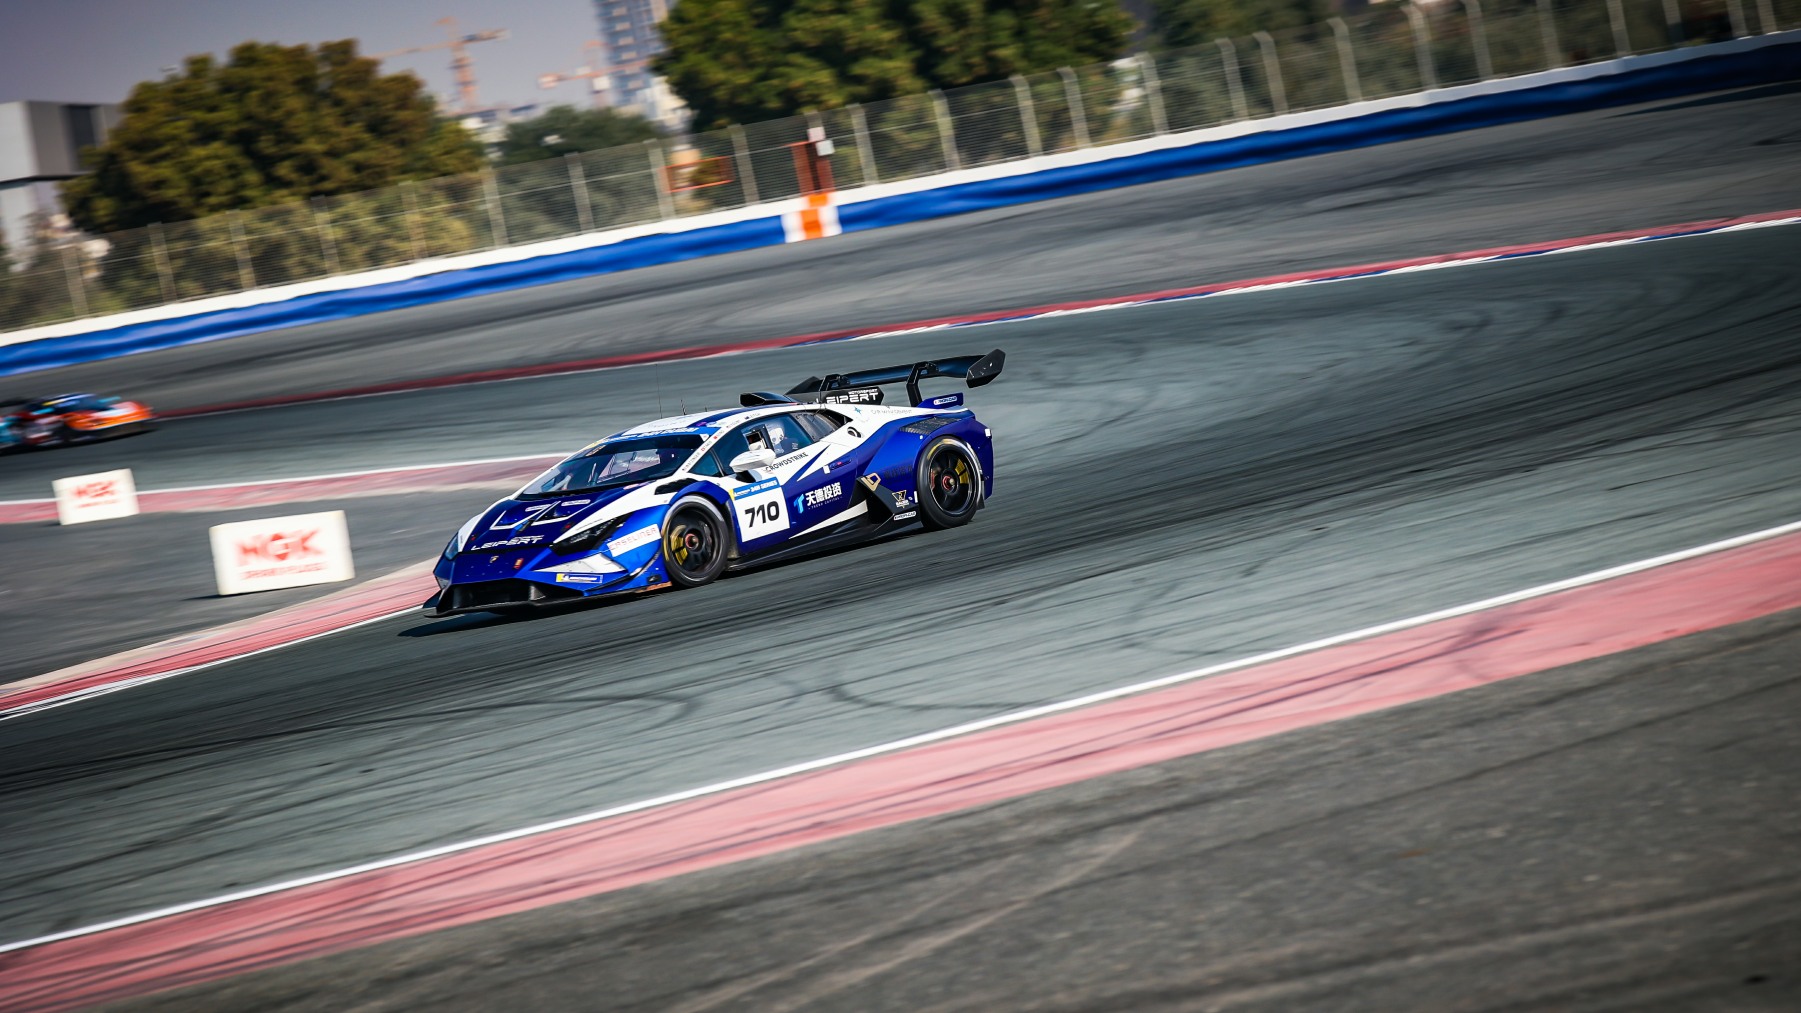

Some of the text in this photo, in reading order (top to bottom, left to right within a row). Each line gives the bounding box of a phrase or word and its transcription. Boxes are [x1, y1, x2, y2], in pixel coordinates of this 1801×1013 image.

[764, 451, 809, 473] CROWDSTRIKE
[804, 481, 842, 506] 天德投资
[744, 500, 780, 528] 710
[470, 536, 545, 551] LEIPERT
